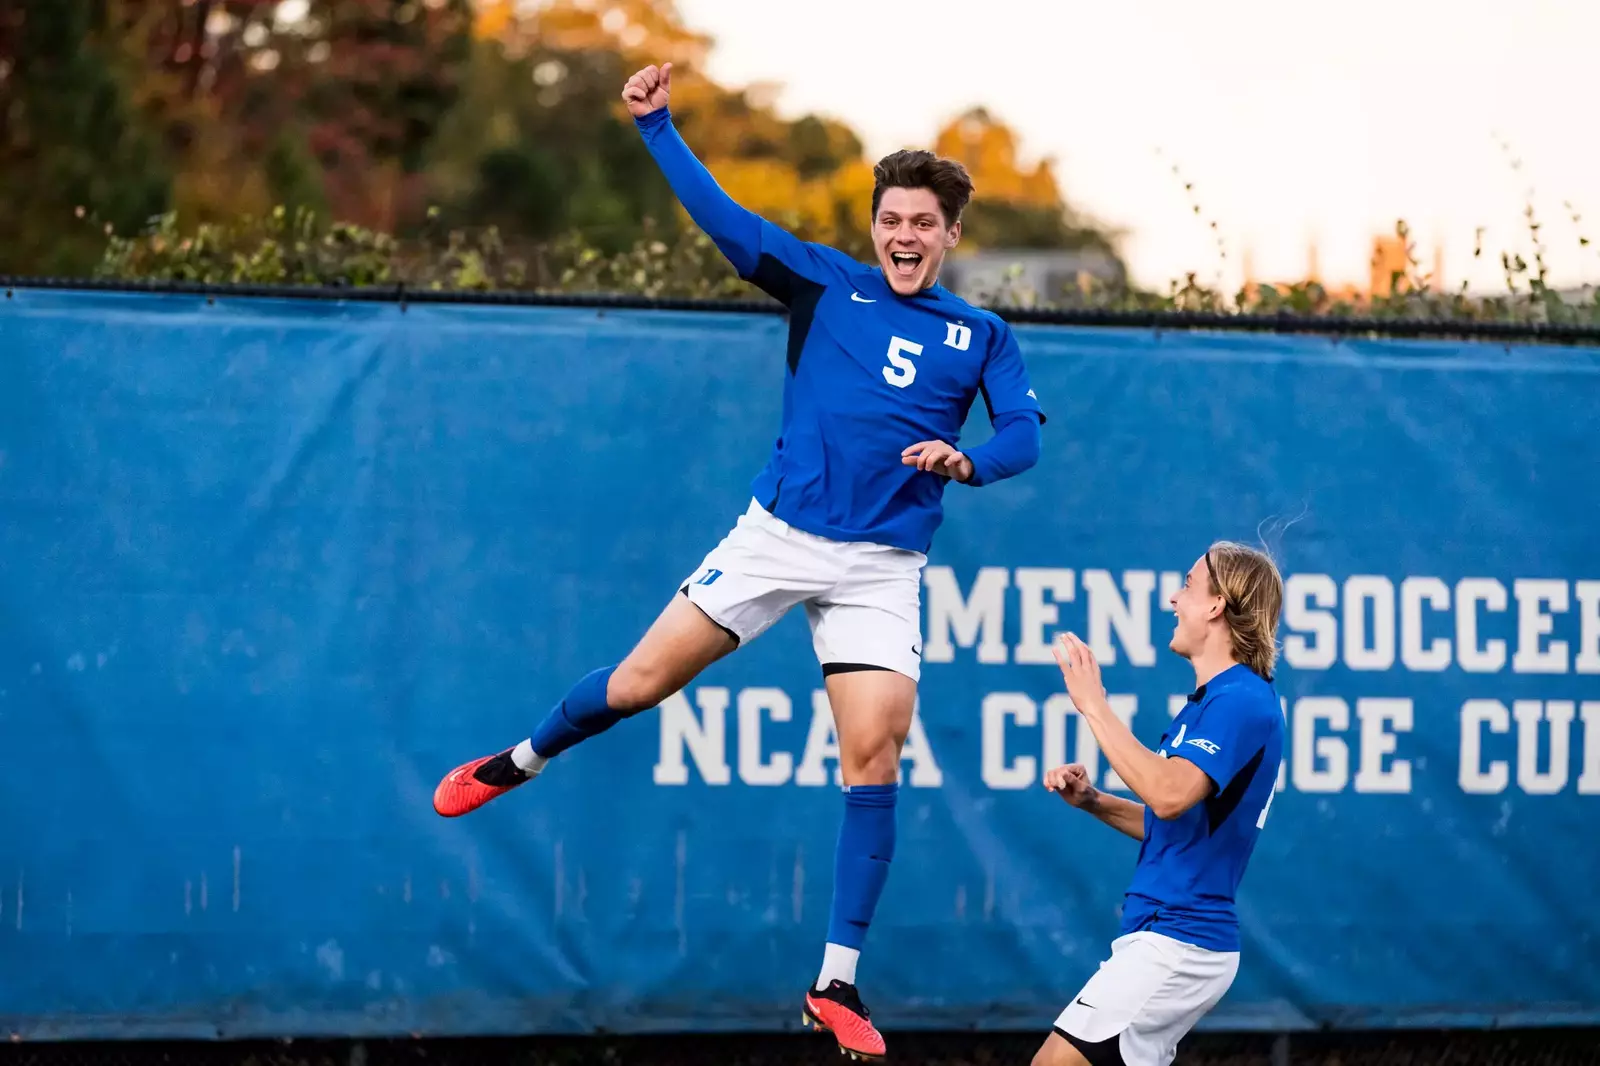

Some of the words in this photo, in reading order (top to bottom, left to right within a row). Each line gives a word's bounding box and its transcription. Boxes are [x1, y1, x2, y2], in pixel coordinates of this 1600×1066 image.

[943, 322, 972, 351] D
[882, 336, 924, 389] 5
[924, 566, 1184, 668] MEN'
[1185, 738, 1221, 755] ACC
